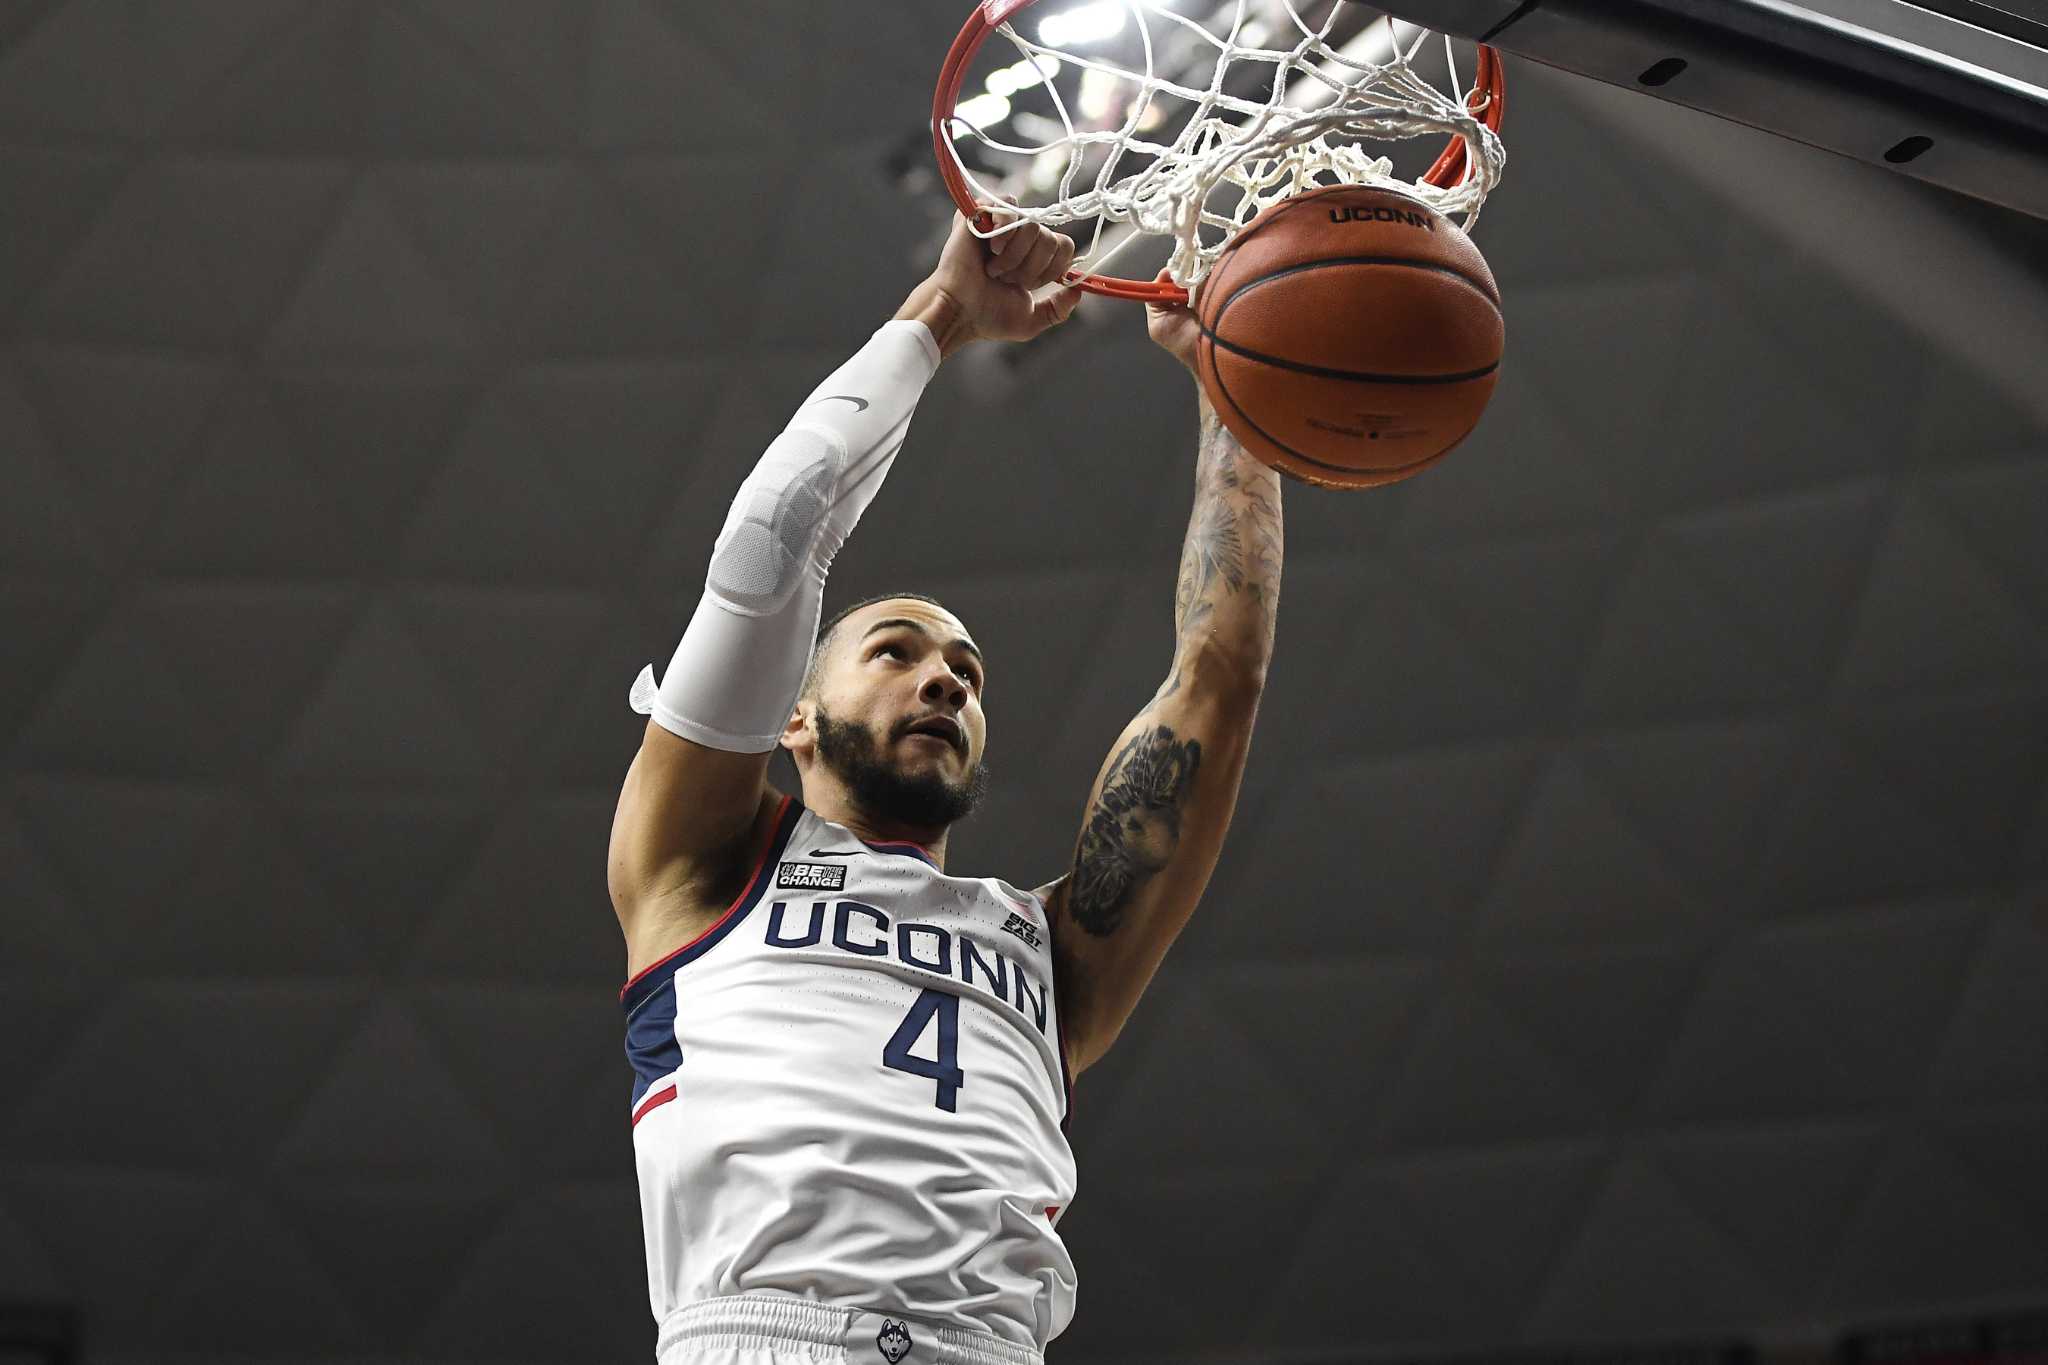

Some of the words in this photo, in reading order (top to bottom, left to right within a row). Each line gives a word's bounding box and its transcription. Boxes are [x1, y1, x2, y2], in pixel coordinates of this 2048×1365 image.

[1329, 207, 1435, 233] UCONN
[779, 875, 842, 888] CHANGE
[1003, 919, 1043, 948] EAST
[1009, 911, 1038, 934] BIG
[764, 901, 1047, 1036] UCONN
[882, 987, 964, 1114] 4
